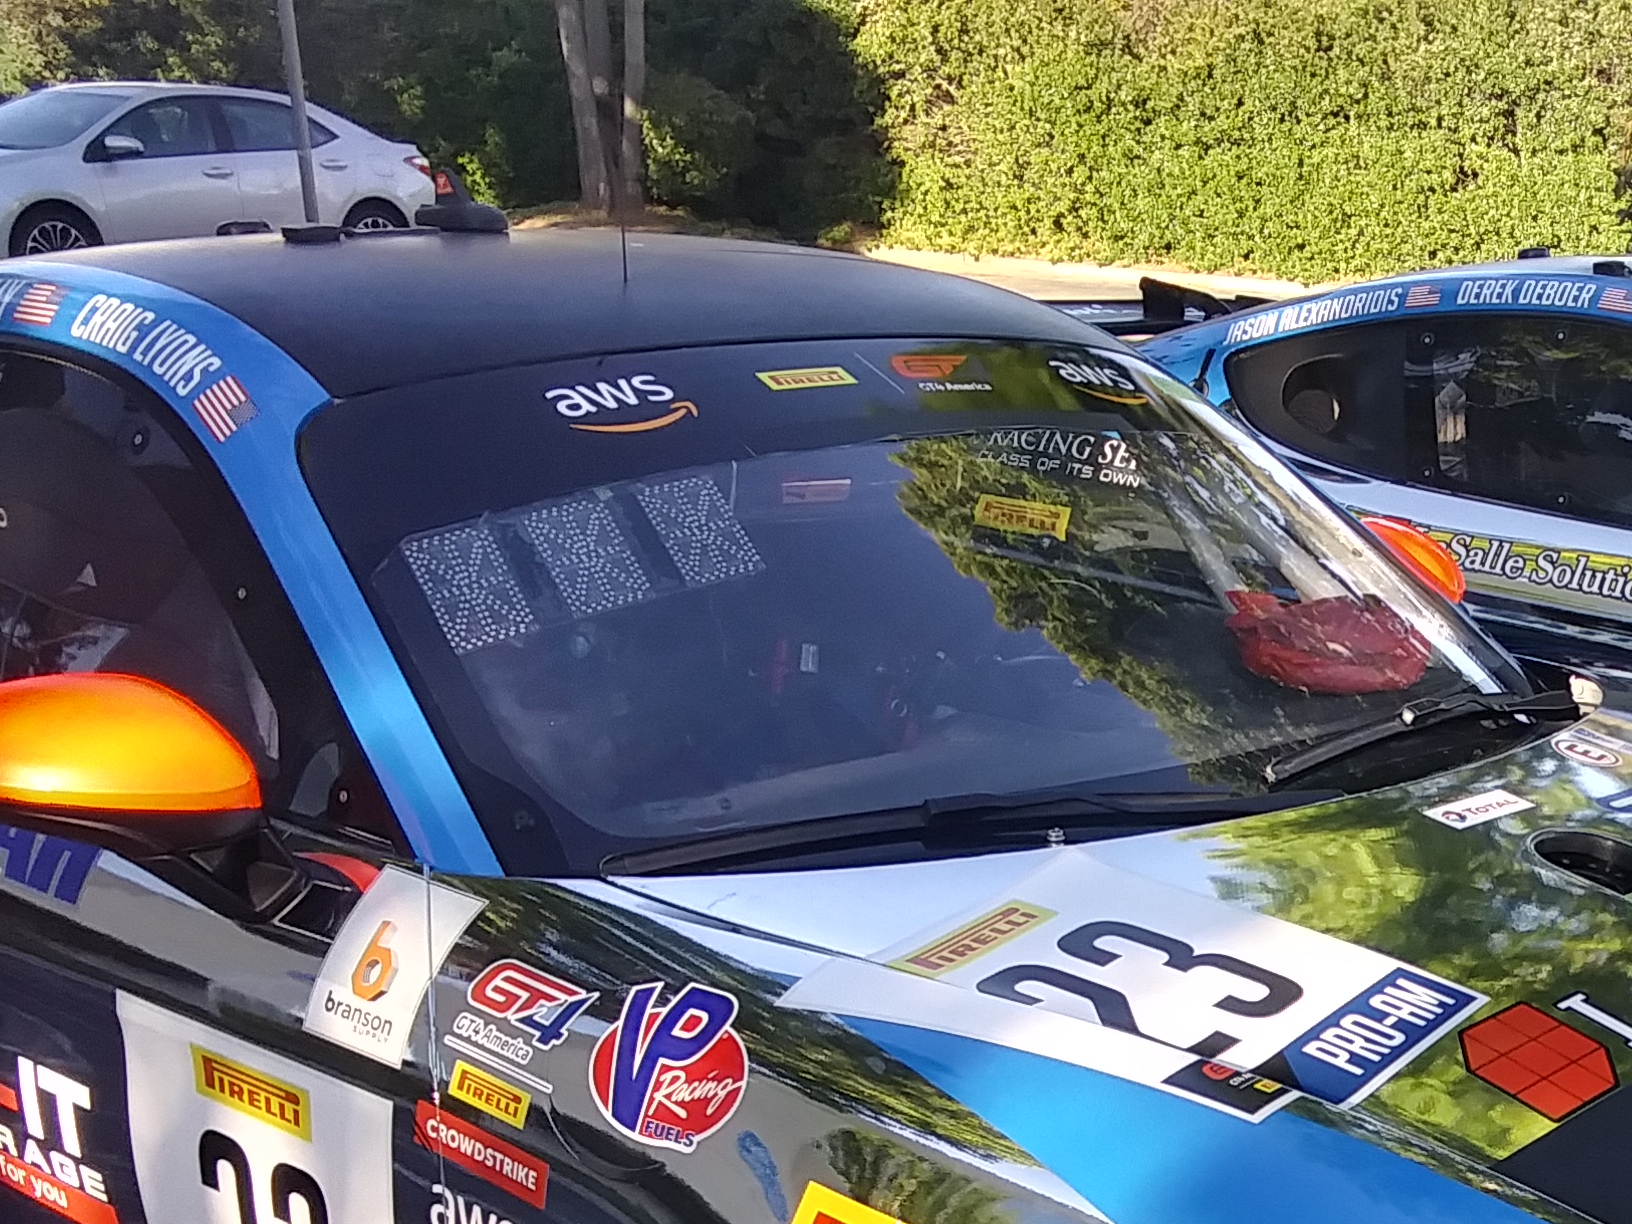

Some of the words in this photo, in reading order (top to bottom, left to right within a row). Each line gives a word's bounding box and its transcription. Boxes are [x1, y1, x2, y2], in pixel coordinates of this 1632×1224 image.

[1222, 311, 1279, 346] JASON
[1278, 288, 1402, 332] ALEXANDRIDIS
[1456, 279, 1515, 305] DEREK
[1518, 280, 1597, 308] DEBOER
[70, 294, 155, 354] CRAIG
[133, 320, 222, 397] LYONS
[544, 374, 674, 418] aws
[768, 371, 847, 386] PIRELLI
[945, 382, 993, 392] America
[1048, 360, 1136, 391] aws
[1066, 462, 1094, 479] ITS
[1099, 467, 1142, 489] OWN
[1466, 798, 1523, 818] TOTAL
[905, 905, 1039, 972] PIRELLI
[325, 990, 392, 1036] branson
[470, 961, 599, 1047] GT4
[976, 920, 1303, 1061] 23
[456, 1014, 482, 1041] GT4
[481, 1025, 531, 1062] America
[1301, 977, 1458, 1075] PRO-AM
[611, 985, 736, 1134] VP
[203, 1054, 300, 1128] PIRELLI
[457, 1069, 522, 1119] PIRELLI
[648, 1070, 744, 1119] Racing
[425, 1118, 537, 1191] CROWDSTRIKE
[644, 1120, 696, 1147] FUELS
[30, 1175, 68, 1209] you
